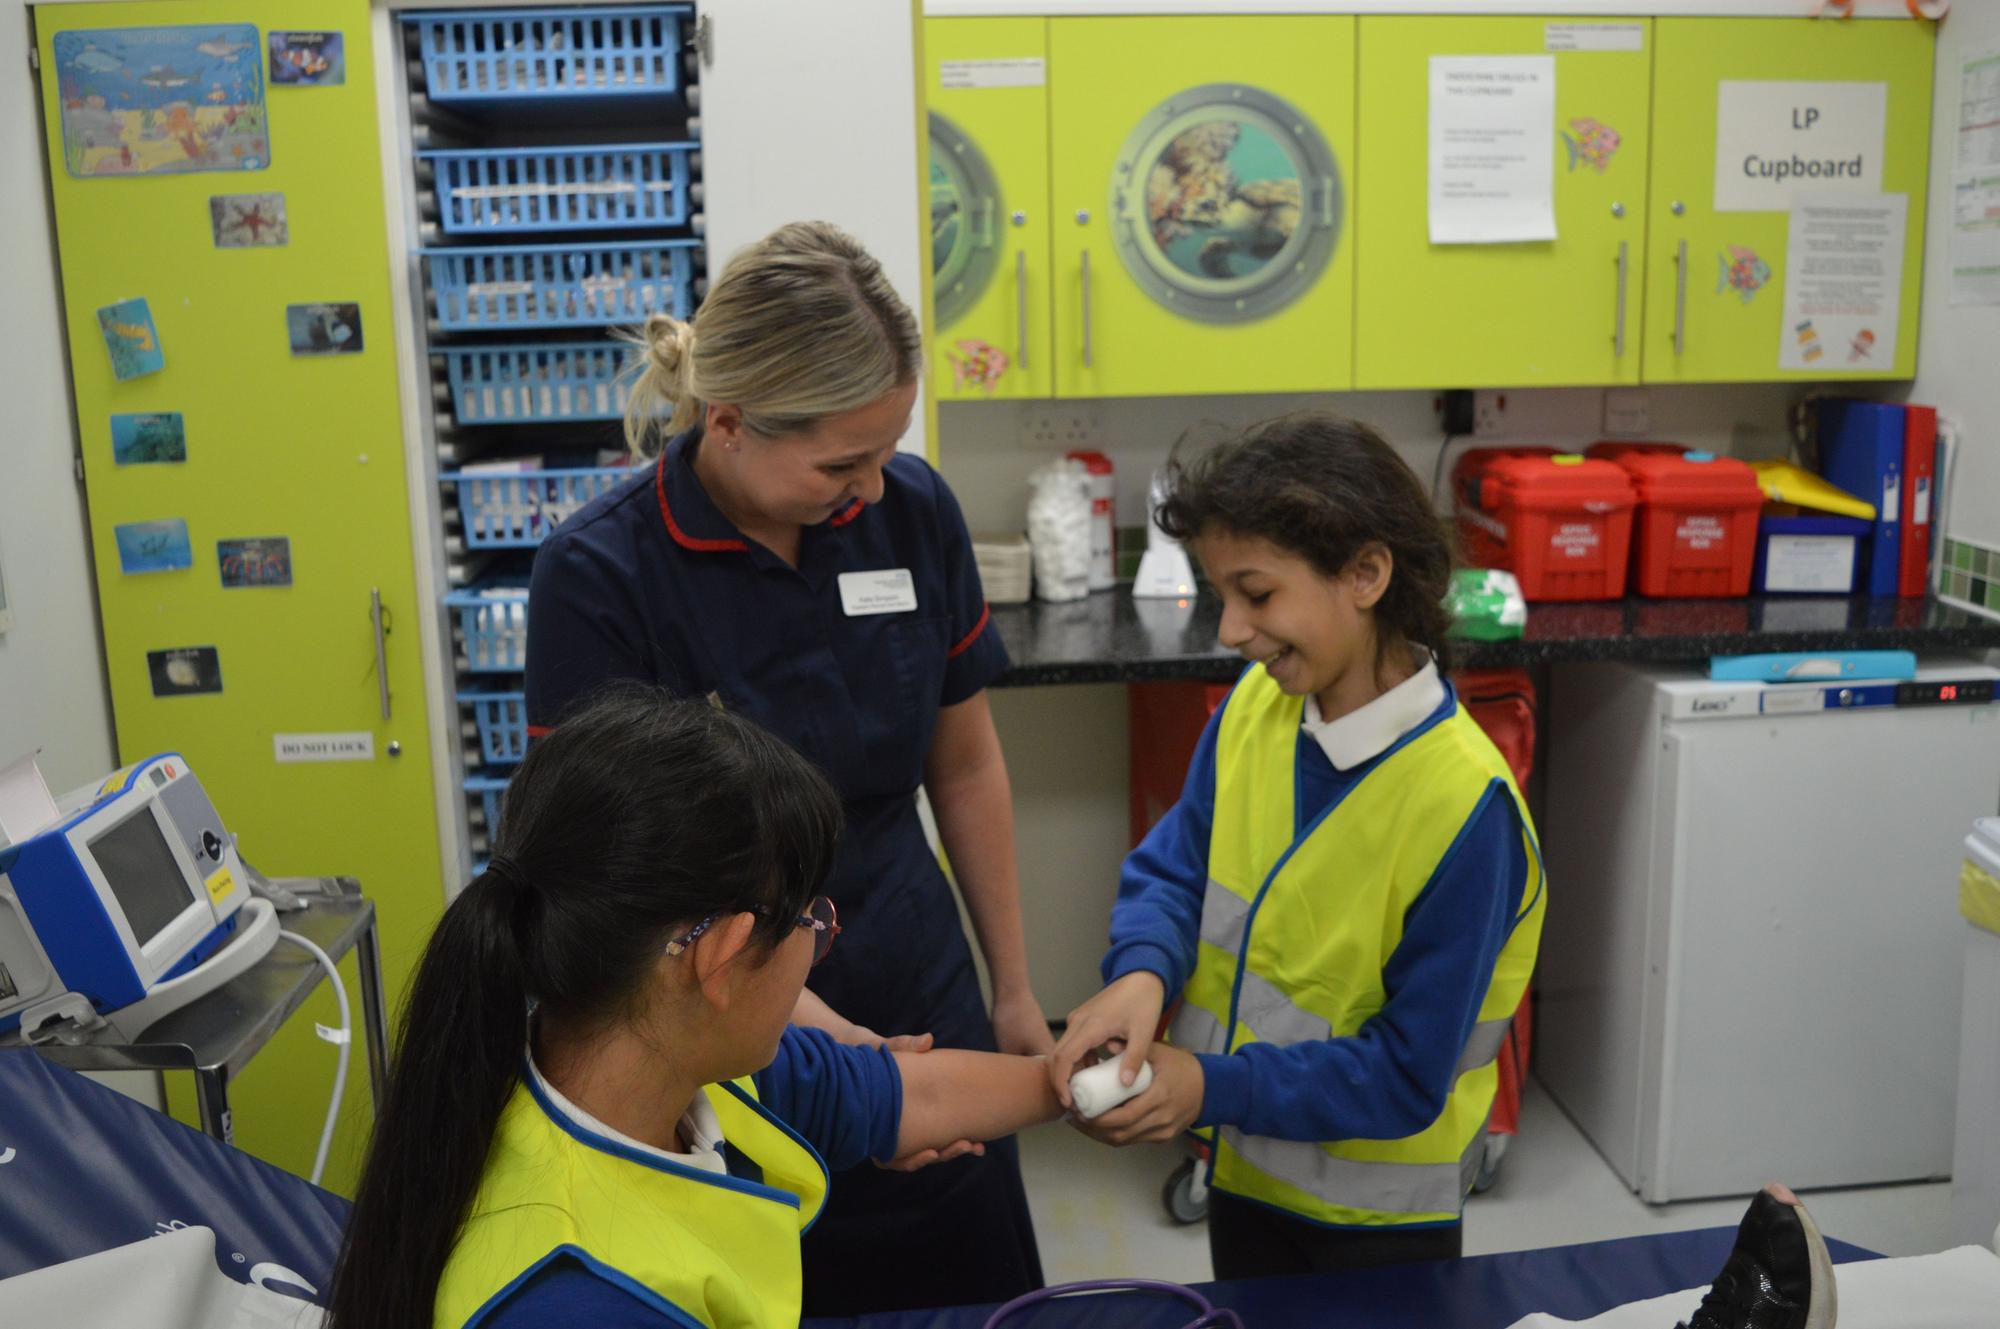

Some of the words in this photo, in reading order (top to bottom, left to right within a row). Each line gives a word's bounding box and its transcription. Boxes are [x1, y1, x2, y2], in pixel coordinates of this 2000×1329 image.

[1791, 107, 1820, 130] LP
[1743, 153, 1863, 184] Cupboard
[282, 743, 301, 754] DO
[303, 742, 328, 753] NOT
[331, 741, 367, 752] LOCK
